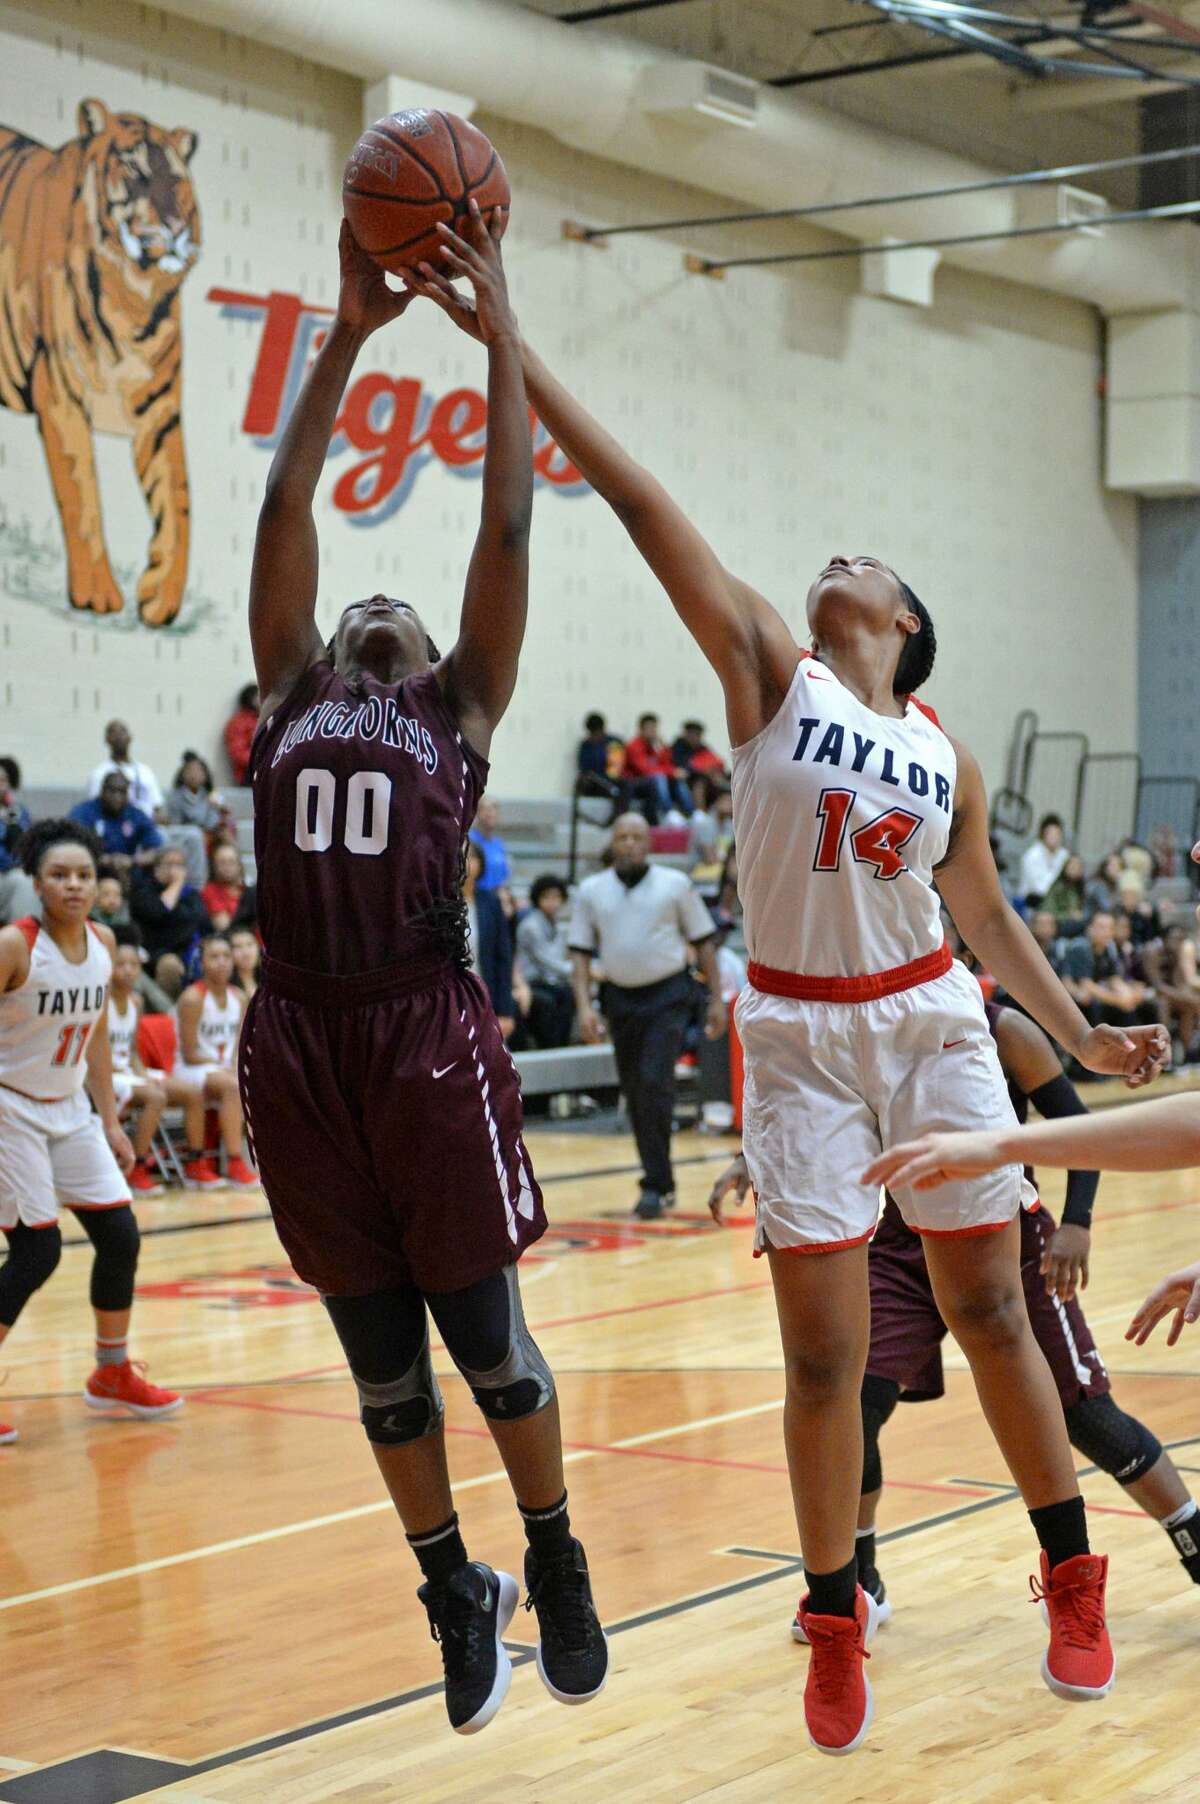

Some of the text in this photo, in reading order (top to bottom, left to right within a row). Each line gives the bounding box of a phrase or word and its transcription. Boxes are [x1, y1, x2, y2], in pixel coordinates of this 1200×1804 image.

[207, 287, 588, 514] Tges
[792, 718, 950, 814] TAYLOR
[294, 768, 392, 855] 00
[812, 787, 924, 881] 14
[37, 984, 107, 1015] TAYLO
[51, 1023, 91, 1066] 11
